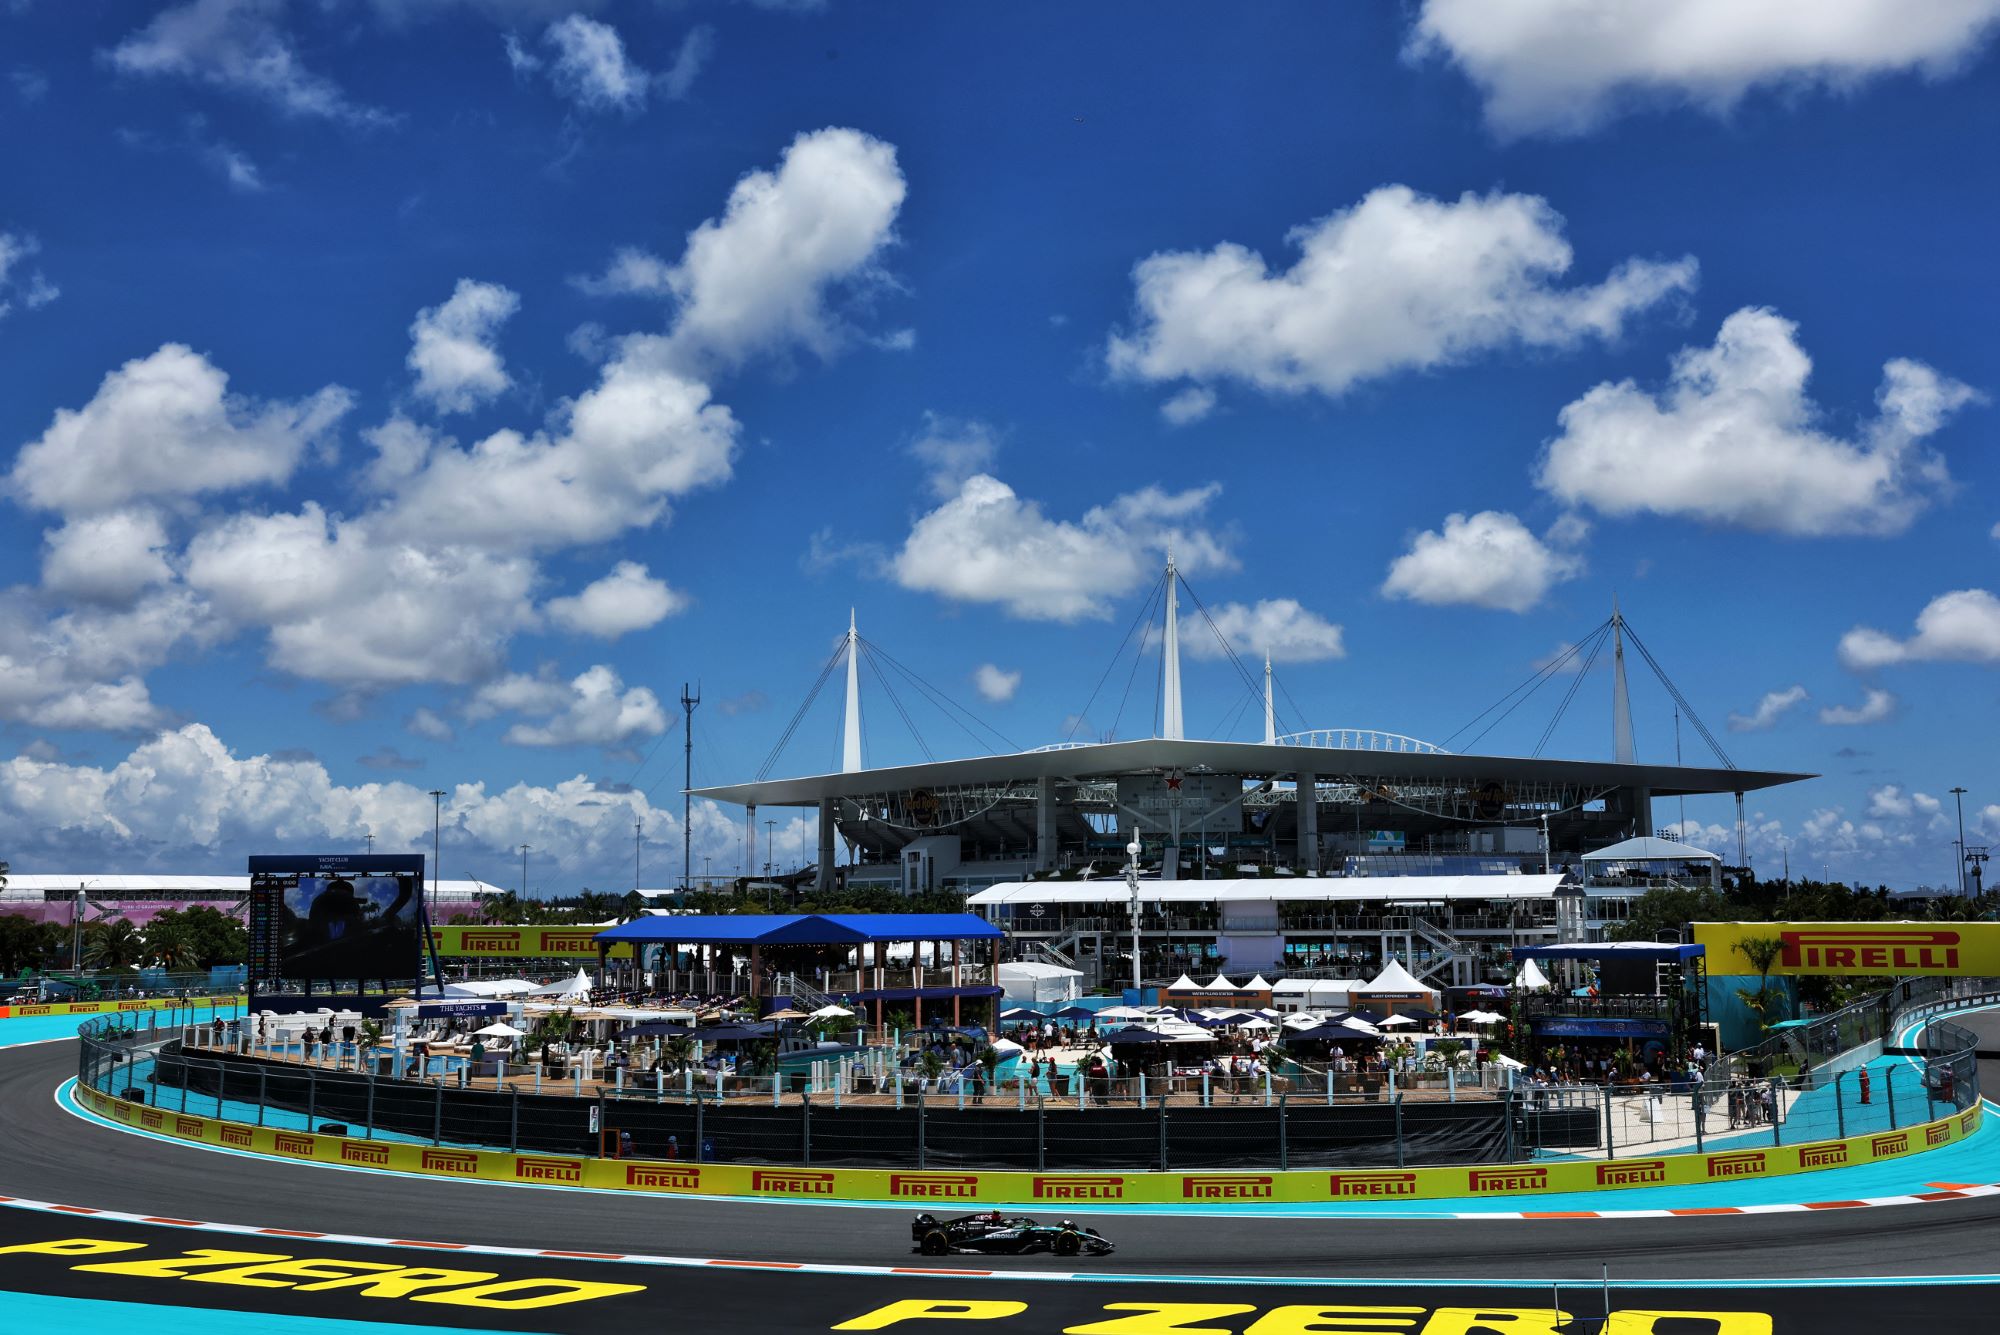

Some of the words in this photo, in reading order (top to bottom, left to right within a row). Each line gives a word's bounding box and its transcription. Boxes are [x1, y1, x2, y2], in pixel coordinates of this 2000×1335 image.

[461, 932, 520, 951] PIRELLI
[541, 932, 600, 952] PIRELL
[1781, 931, 1960, 968] PIRELLI
[20, 1006, 50, 1016] PIRELLI
[69, 1004, 99, 1013] PIRELLI
[118, 1001, 147, 1011] PIRELLI
[455, 1004, 480, 1012] YACHTS
[141, 1110, 163, 1129] PIRELLI
[176, 1118, 204, 1137] PIRELLI
[220, 1125, 253, 1147] PIRELLI
[275, 1133, 313, 1155] PIRELLI
[1872, 1133, 1908, 1157] PIRELLI
[1926, 1123, 1951, 1145] PIRELLI
[342, 1141, 389, 1165] PIRELLI
[422, 1150, 477, 1174] PIRELLI
[1799, 1143, 1847, 1168] PIRELLI
[516, 1157, 582, 1182] PIRELLI
[1597, 1161, 1666, 1185] PIRELLI
[1707, 1152, 1766, 1177] PIRELLI
[626, 1165, 700, 1189] PIRELLI
[752, 1170, 834, 1194] PIRELLI
[890, 1174, 978, 1197] PIRELLI
[1033, 1176, 1124, 1198] PIRELLI
[1183, 1176, 1273, 1198] PIRELLI
[1330, 1173, 1416, 1195] PIRELLI
[1469, 1168, 1548, 1191] PIRELLI
[70, 1249, 648, 1310] ZERO
[832, 1299, 1029, 1330] P
[1062, 1302, 1774, 1335] ZERO
